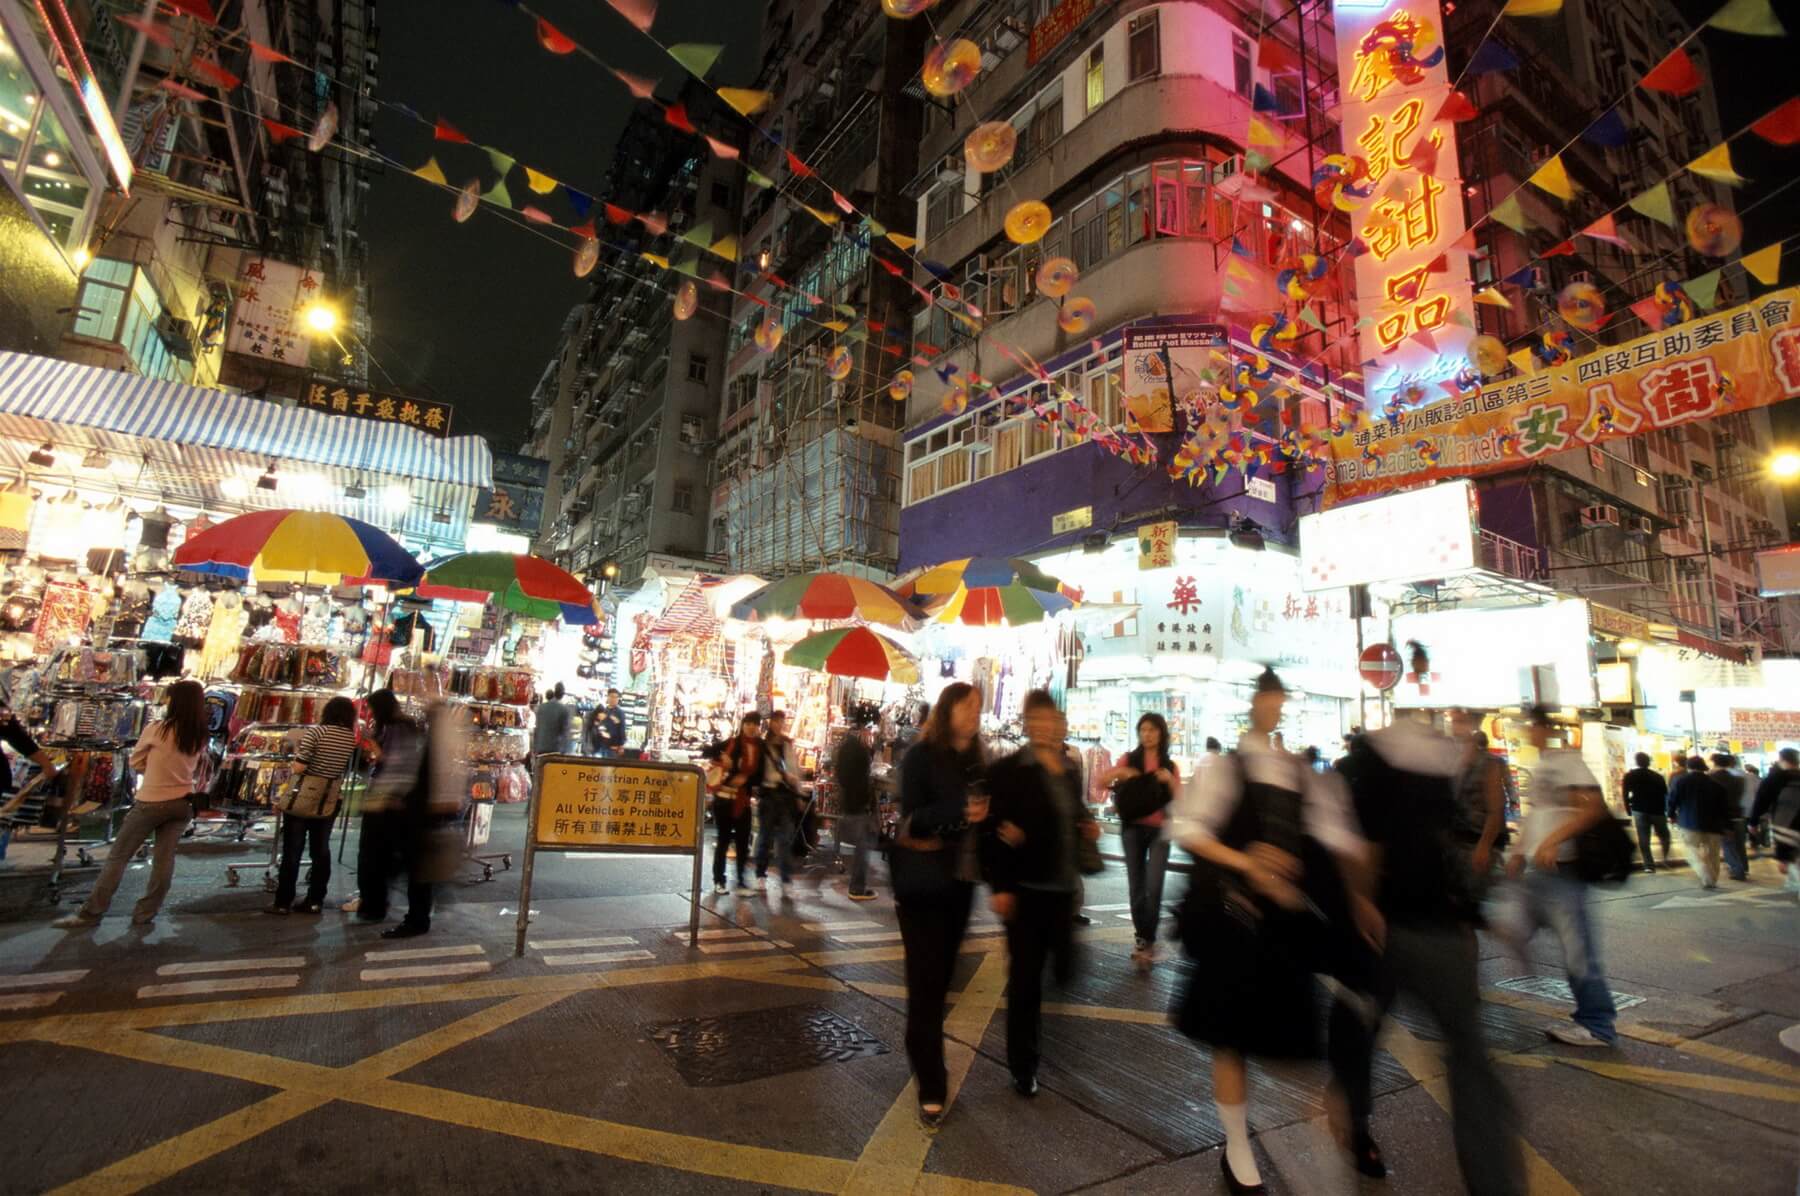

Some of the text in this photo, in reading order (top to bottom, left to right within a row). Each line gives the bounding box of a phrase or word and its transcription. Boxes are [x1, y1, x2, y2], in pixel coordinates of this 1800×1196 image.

[1513, 356, 1716, 456] 女人街
[1439, 428, 1498, 466] Market
[1167, 575, 1202, 616] 藥
[577, 772, 669, 786] Pedestrian Area
[584, 787, 663, 805] 行人專用區
[555, 804, 684, 819] All Vehicles Prohibited
[553, 818, 683, 839] 所有車輛禁止駛入
